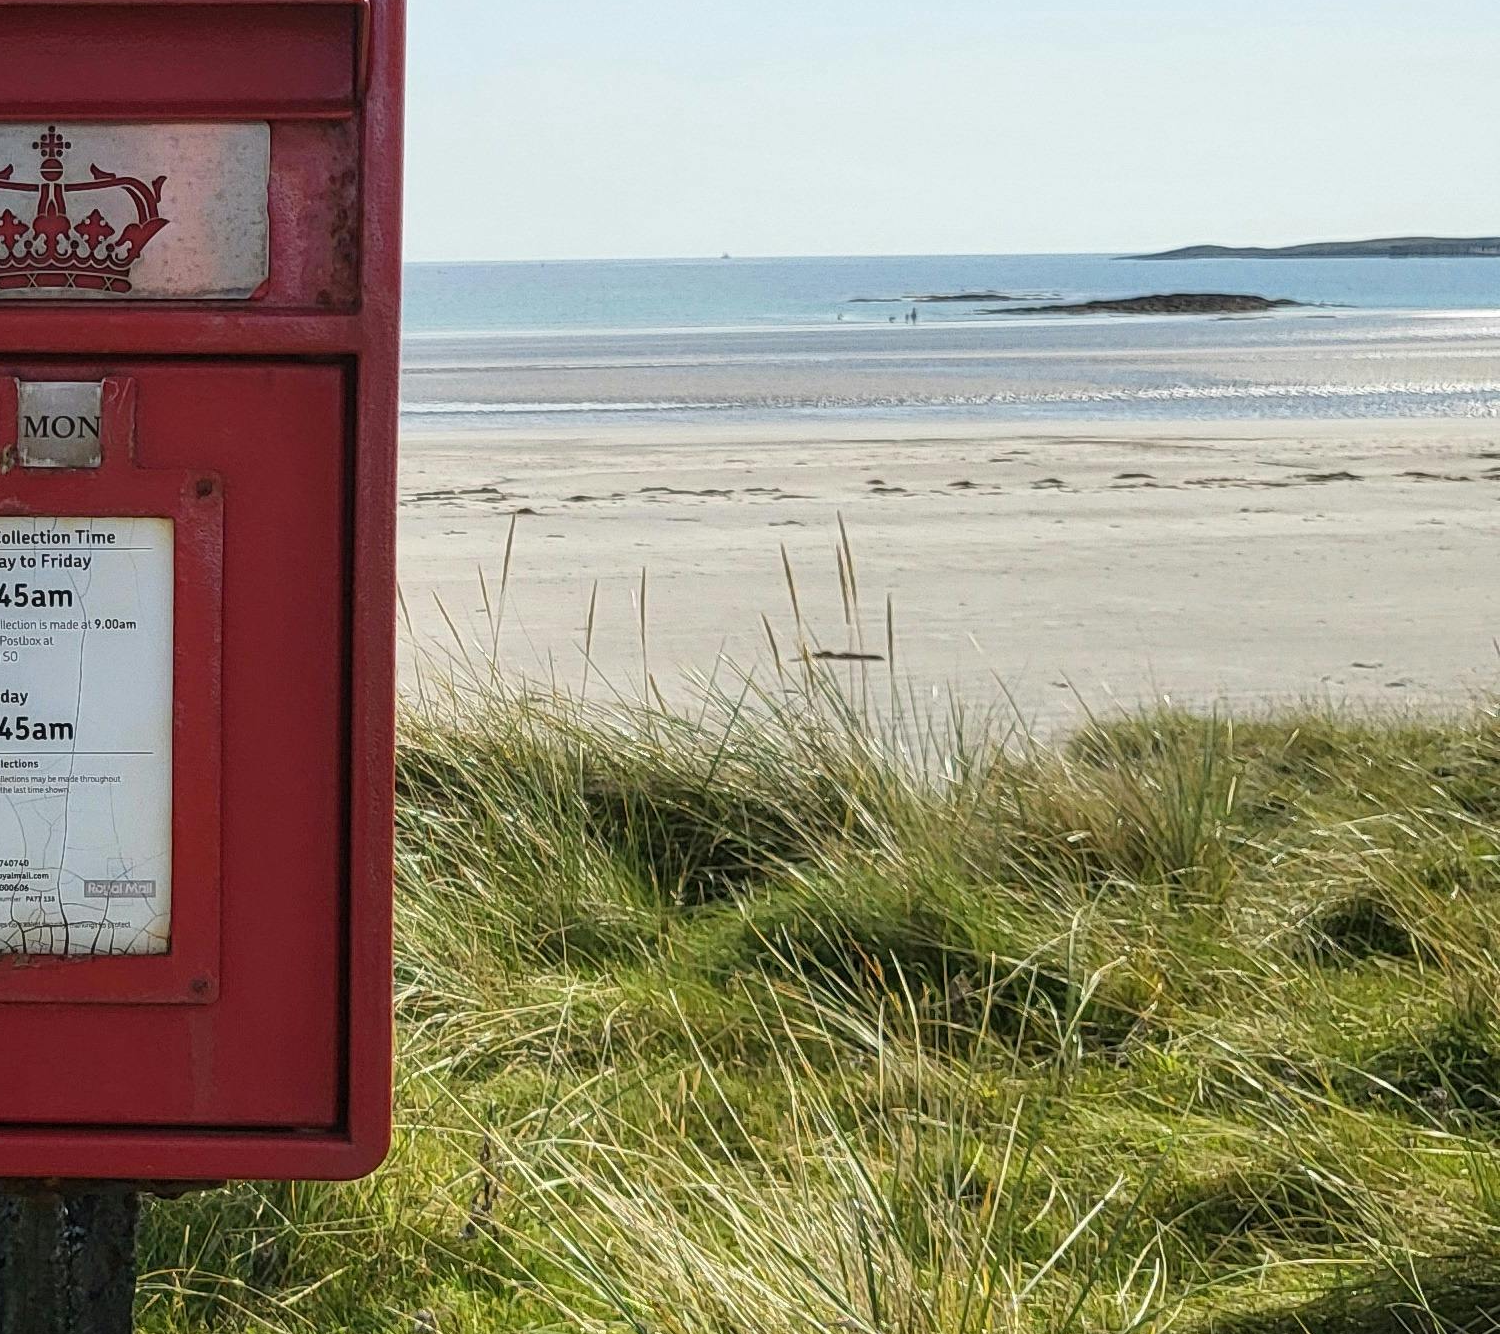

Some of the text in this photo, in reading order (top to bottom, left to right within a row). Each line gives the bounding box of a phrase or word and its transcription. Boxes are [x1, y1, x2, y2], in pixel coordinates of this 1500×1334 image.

[23, 415, 101, 439] MON
[75, 529, 116, 545] Time
[20, 554, 37, 569] to
[41, 553, 92, 571] Friday
[39, 619, 48, 630] is
[50, 618, 79, 630] made
[81, 619, 93, 630] at
[94, 618, 137, 630] 9.00am
[0, 635, 42, 646] Postbox
[43, 636, 54, 646] at
[2, 650, 19, 663] SO
[30, 776, 47, 785] may
[47, 774, 57, 783] be
[57, 775, 79, 783] made
[80, 774, 121, 785] throughout
[0, 786, 13, 794] the
[13, 786, 26, 794] last
[27, 786, 44, 794] time
[87, 882, 153, 896] Royal Mail
